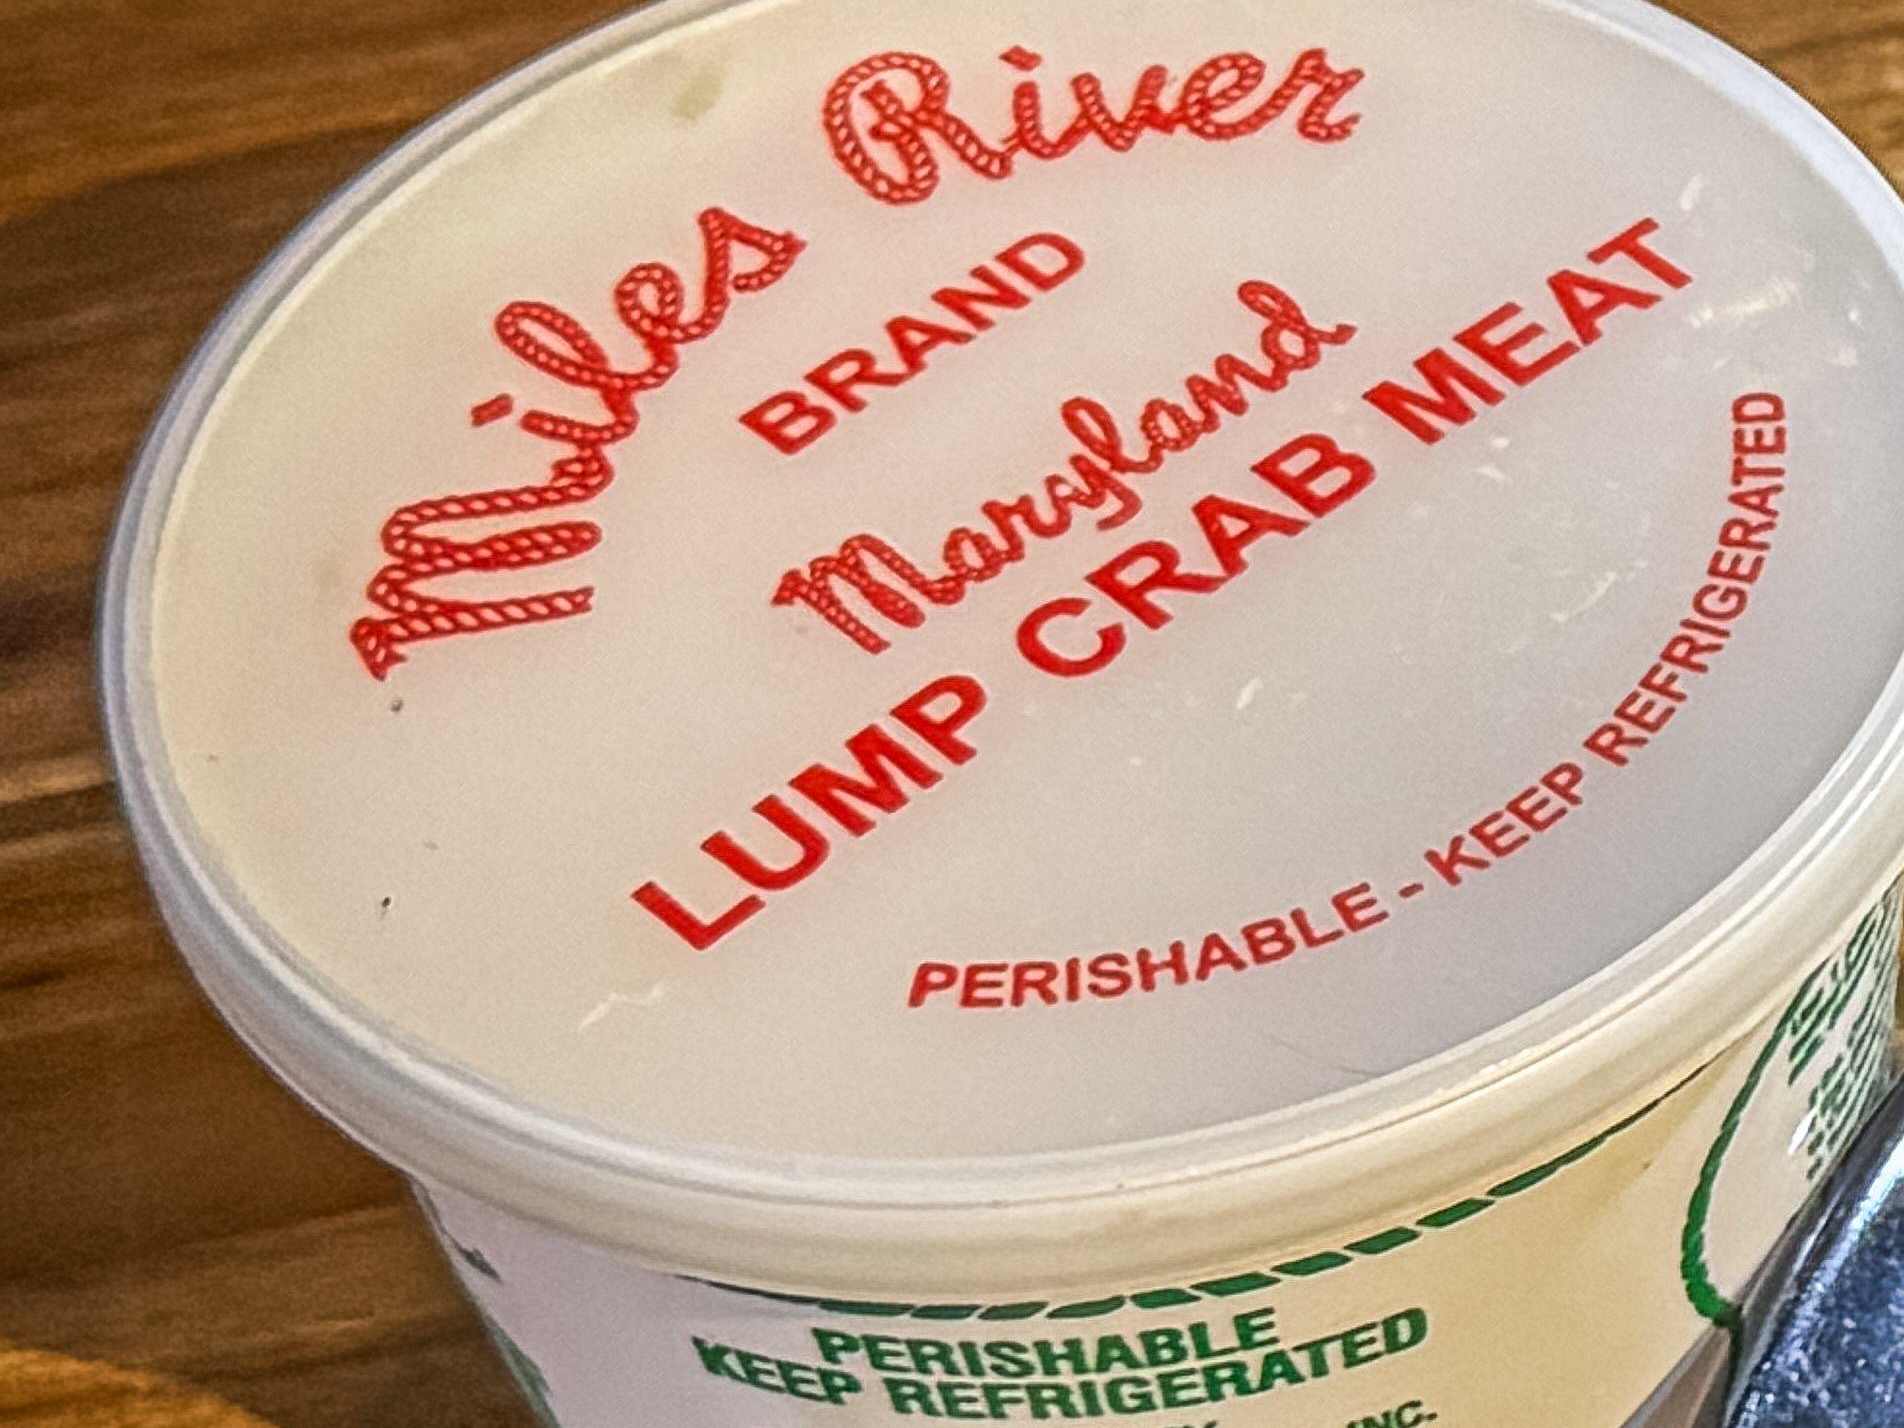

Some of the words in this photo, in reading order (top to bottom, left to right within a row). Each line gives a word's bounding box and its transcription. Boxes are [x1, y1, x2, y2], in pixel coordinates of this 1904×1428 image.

[350, 205, 807, 681] Miles
[822, 45, 1364, 206] River
[738, 232, 1085, 456] BRAND
[771, 280, 1358, 655] Maryland
[630, 673, 988, 952] LUMP
[1016, 432, 1377, 678] CRAB
[1361, 217, 1693, 446] MEAT
[906, 881, 1390, 1009] PERISHABLE
[1424, 761, 1585, 886] KEEP
[1583, 391, 1787, 768] REFRIGERATED
[691, 1334, 863, 1406] KEEP
[881, 1307, 1428, 1420] REFRIGERATED
[811, 1306, 1281, 1378] PERISHABLE
